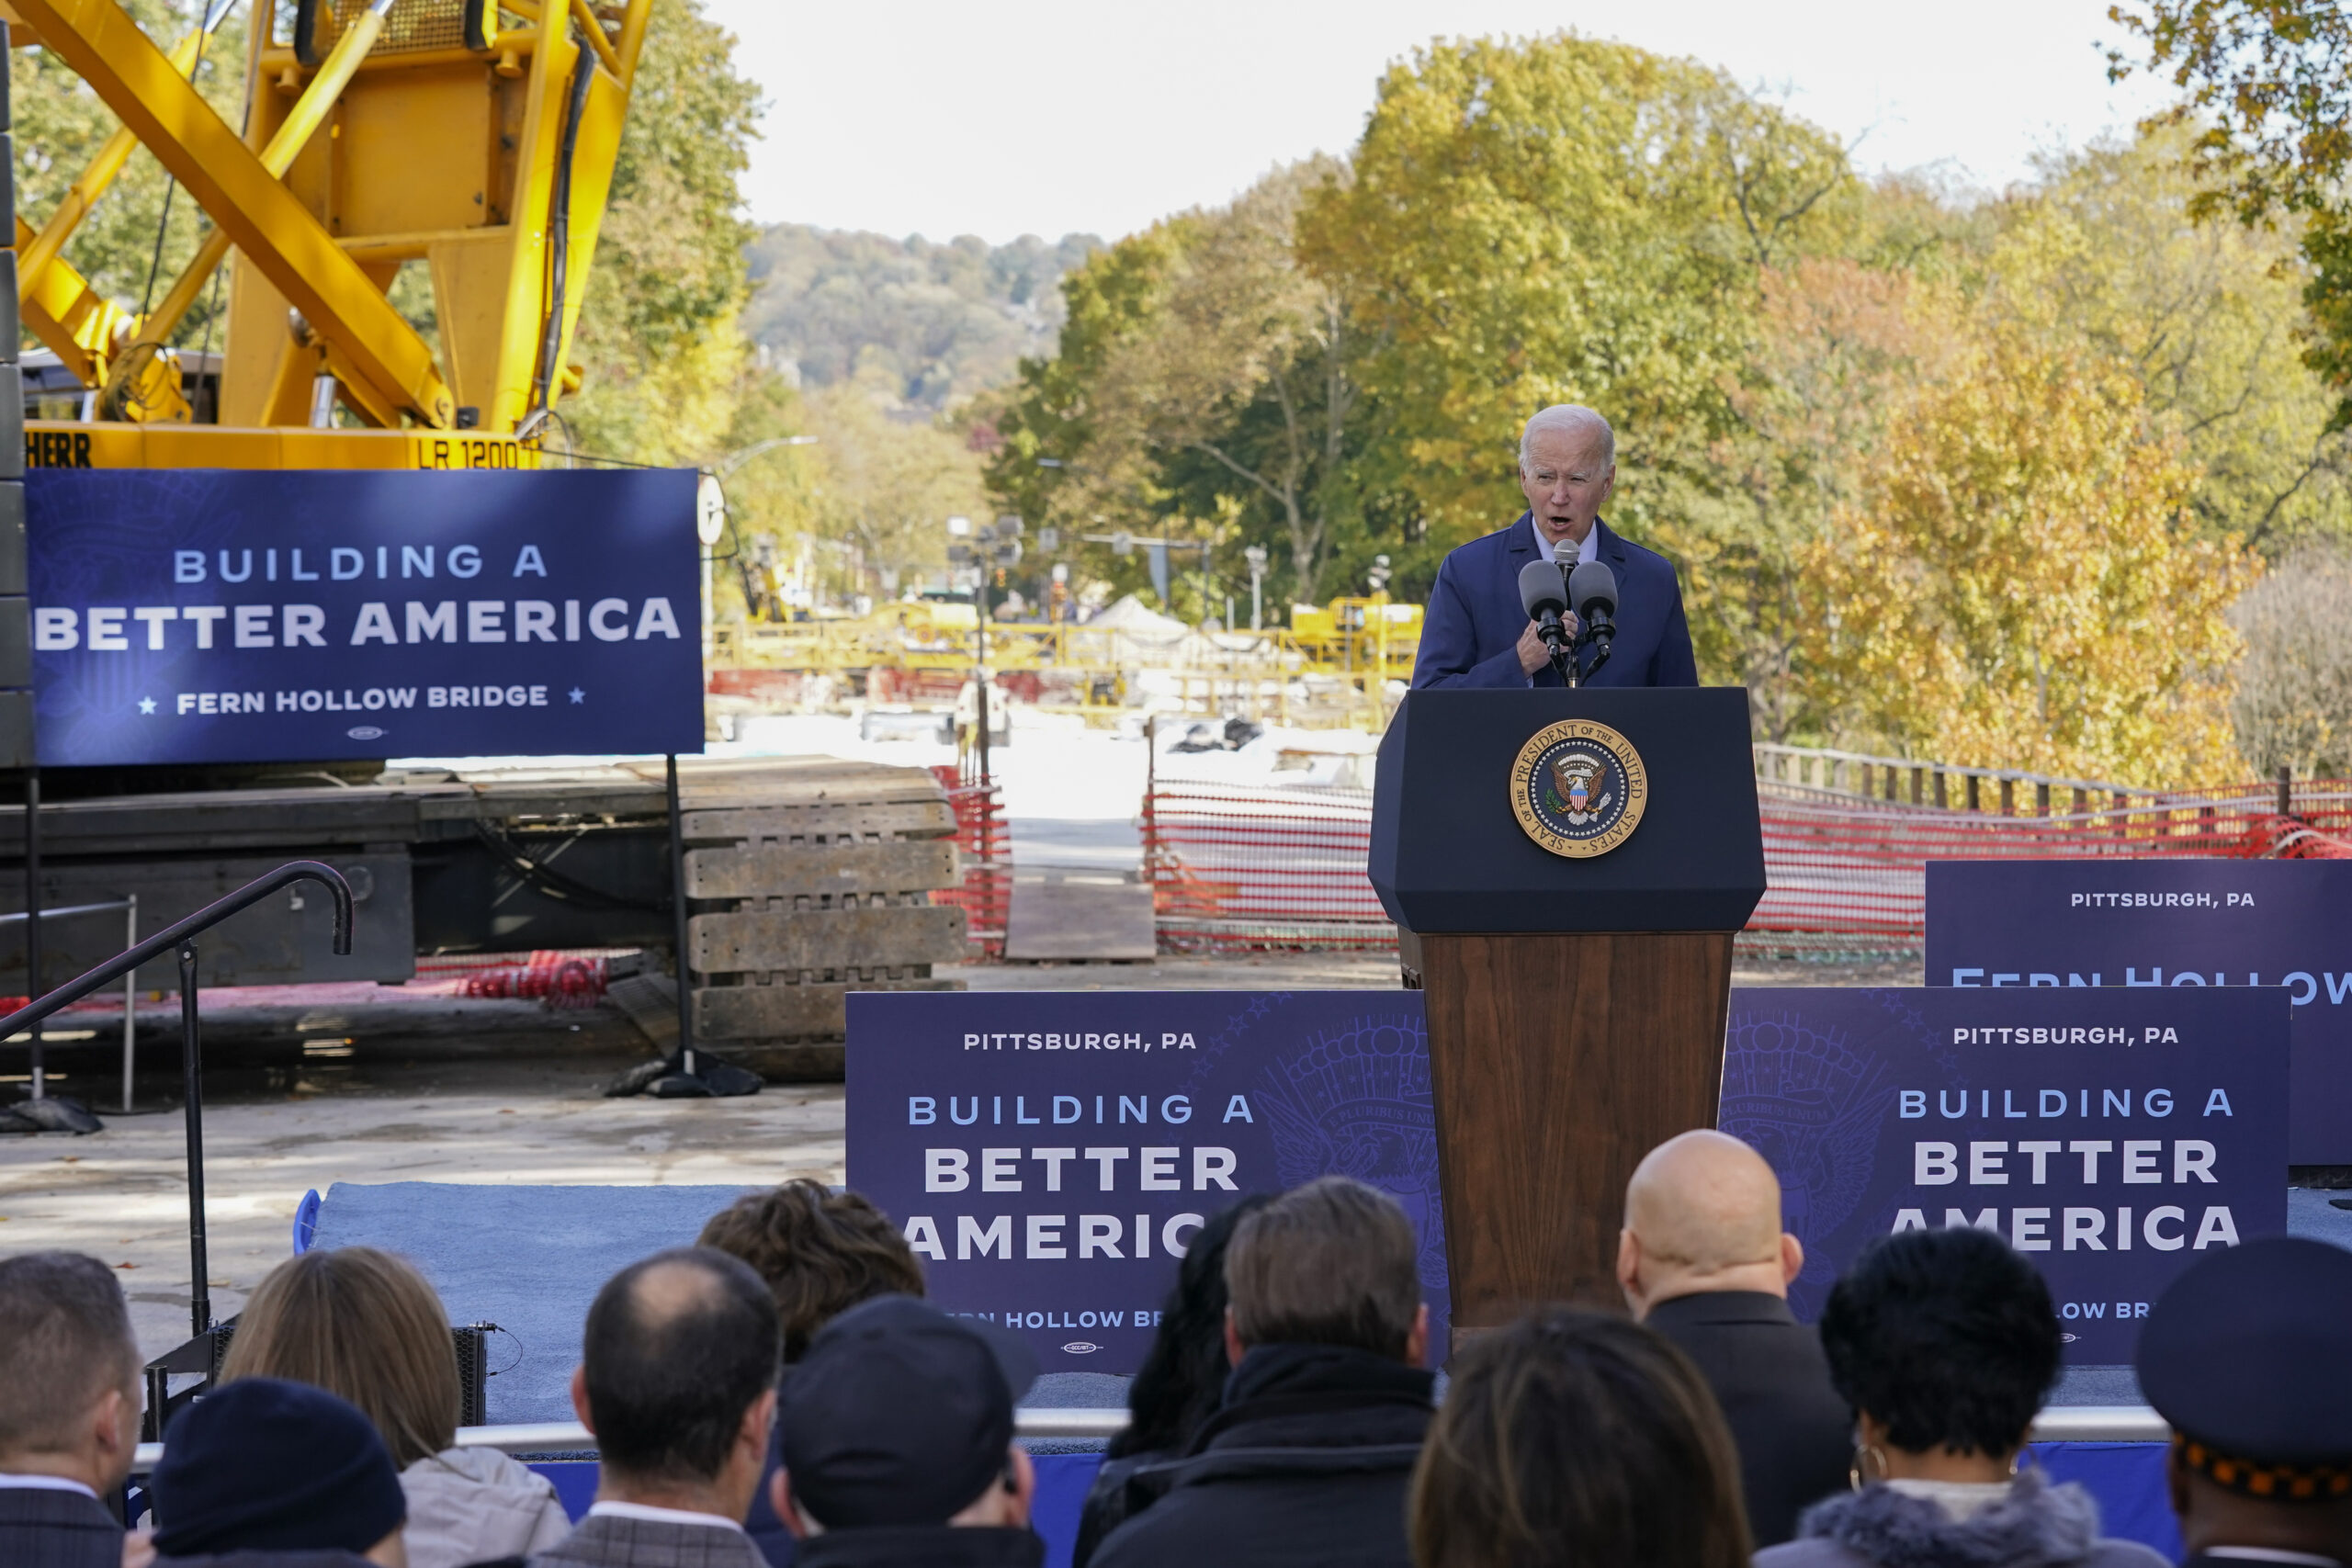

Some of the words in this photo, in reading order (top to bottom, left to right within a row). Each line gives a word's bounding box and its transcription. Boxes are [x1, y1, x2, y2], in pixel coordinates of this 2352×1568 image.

[26, 433, 91, 468] HERR
[419, 441, 448, 468] LR
[461, 441, 517, 468] 1200
[175, 545, 481, 582] BUILDING
[514, 546, 546, 577] A
[37, 606, 324, 650] BETTER
[351, 598, 680, 645] AMERICA
[177, 694, 263, 715] FERN
[277, 688, 417, 711] HOLLOW
[428, 686, 547, 706] BRIDGE
[1580, 727, 1594, 735] OF
[1596, 729, 1613, 744] THE
[1516, 725, 1577, 784] PRESIDENT
[1615, 742, 1644, 799] UNITED
[1517, 788, 1527, 807] THE
[1521, 809, 1532, 822] OF
[1532, 819, 1566, 851] SEAL
[1589, 811, 1636, 852] STATES
[2072, 893, 2218, 908] PITTSBURGH,
[2227, 893, 2255, 906] PA
[965, 1033, 1150, 1052] PITTSBURGH,
[1162, 1033, 1196, 1049] PA
[1954, 1028, 2134, 1046] PITTSBURGH,
[2145, 1028, 2178, 1043] PA
[910, 1095, 1192, 1124] BUILDING
[1223, 1095, 1253, 1122] A
[1407, 1110, 1434, 1125] UNU
[1900, 1089, 2173, 1118] BUILDING
[2203, 1089, 2233, 1116] A
[925, 1147, 1238, 1192] BETTER
[1915, 1140, 2218, 1185] BETTER
[903, 1213, 1204, 1259] AMERIC
[1892, 1206, 2239, 1250] AMERICA
[1006, 1312, 1124, 1328] HOLLOW
